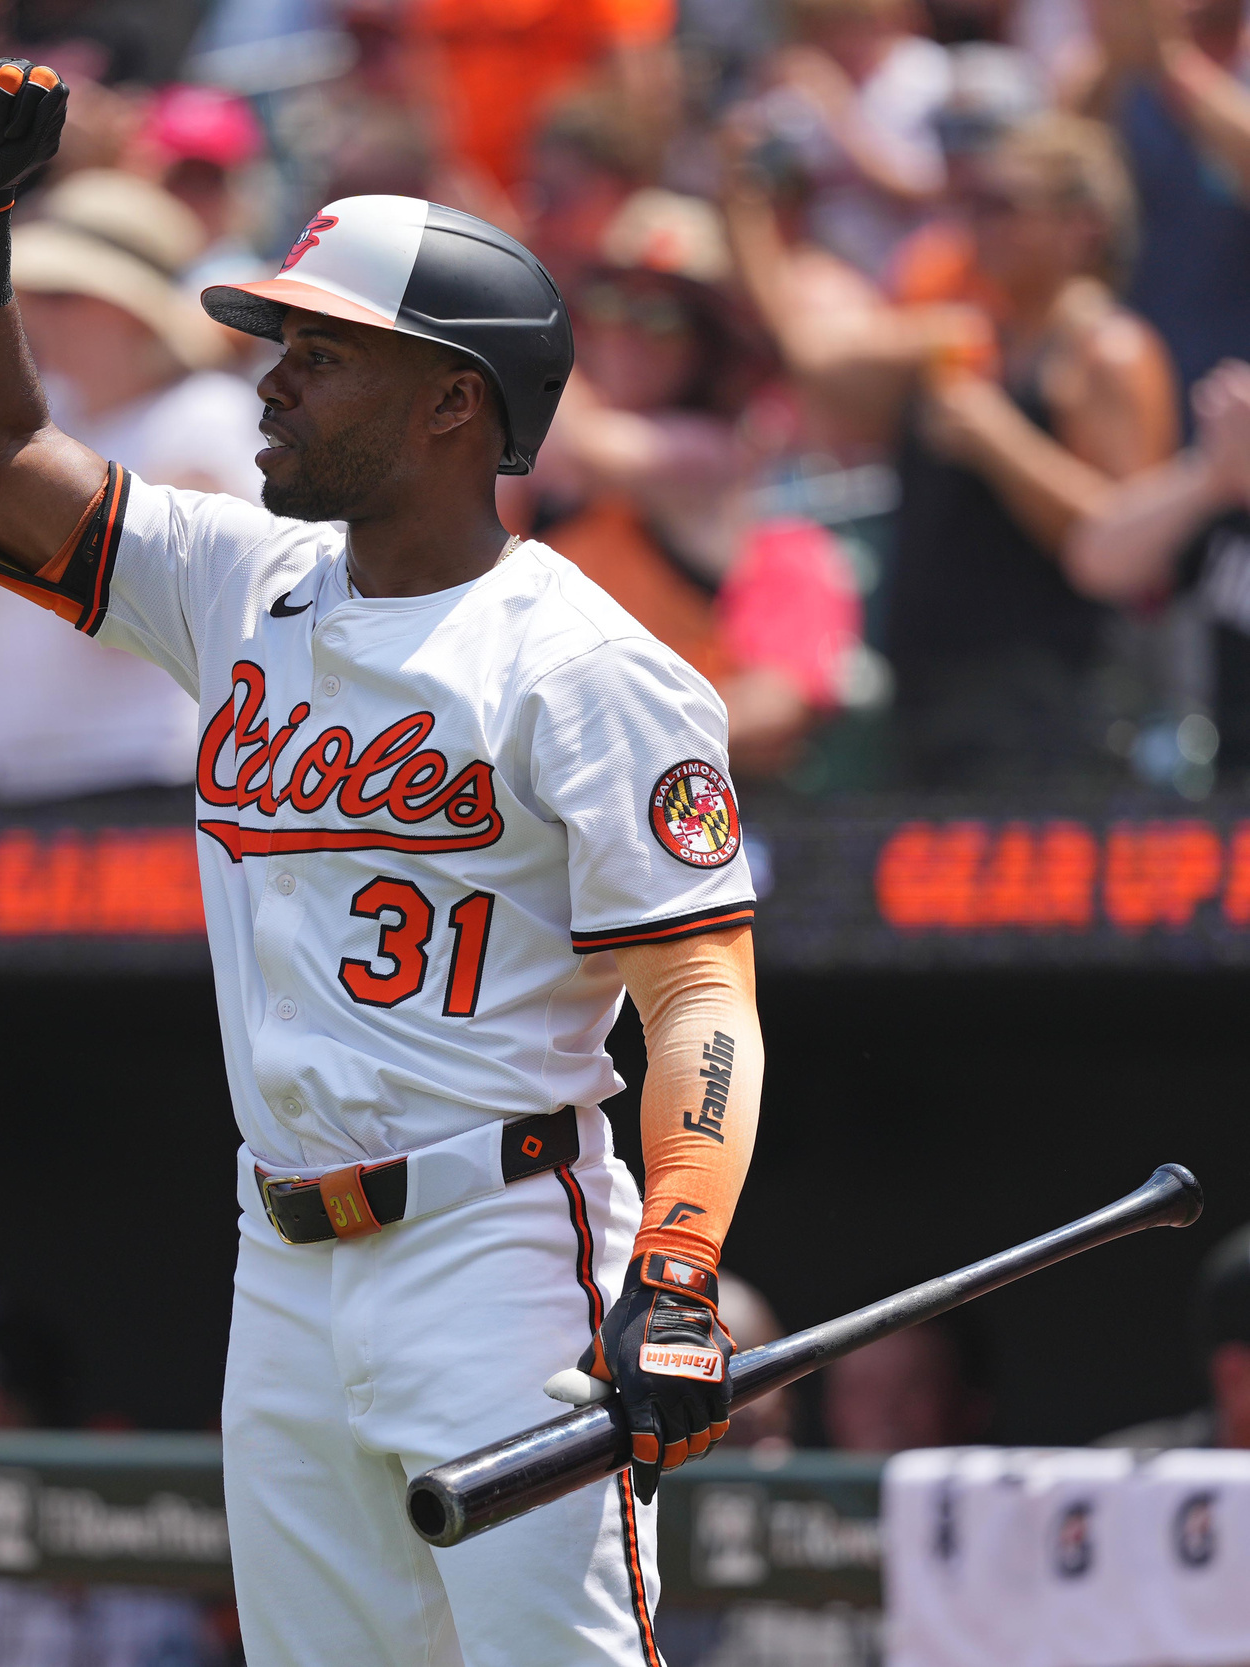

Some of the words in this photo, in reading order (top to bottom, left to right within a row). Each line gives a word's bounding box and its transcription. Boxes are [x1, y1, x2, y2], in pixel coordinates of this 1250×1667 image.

[196, 659, 505, 830] Orioles
[654, 763, 728, 808] BALTIMORE
[679, 835, 738, 864] ORIOLES
[337, 874, 496, 1018] 31
[329, 1192, 363, 1229] 31
